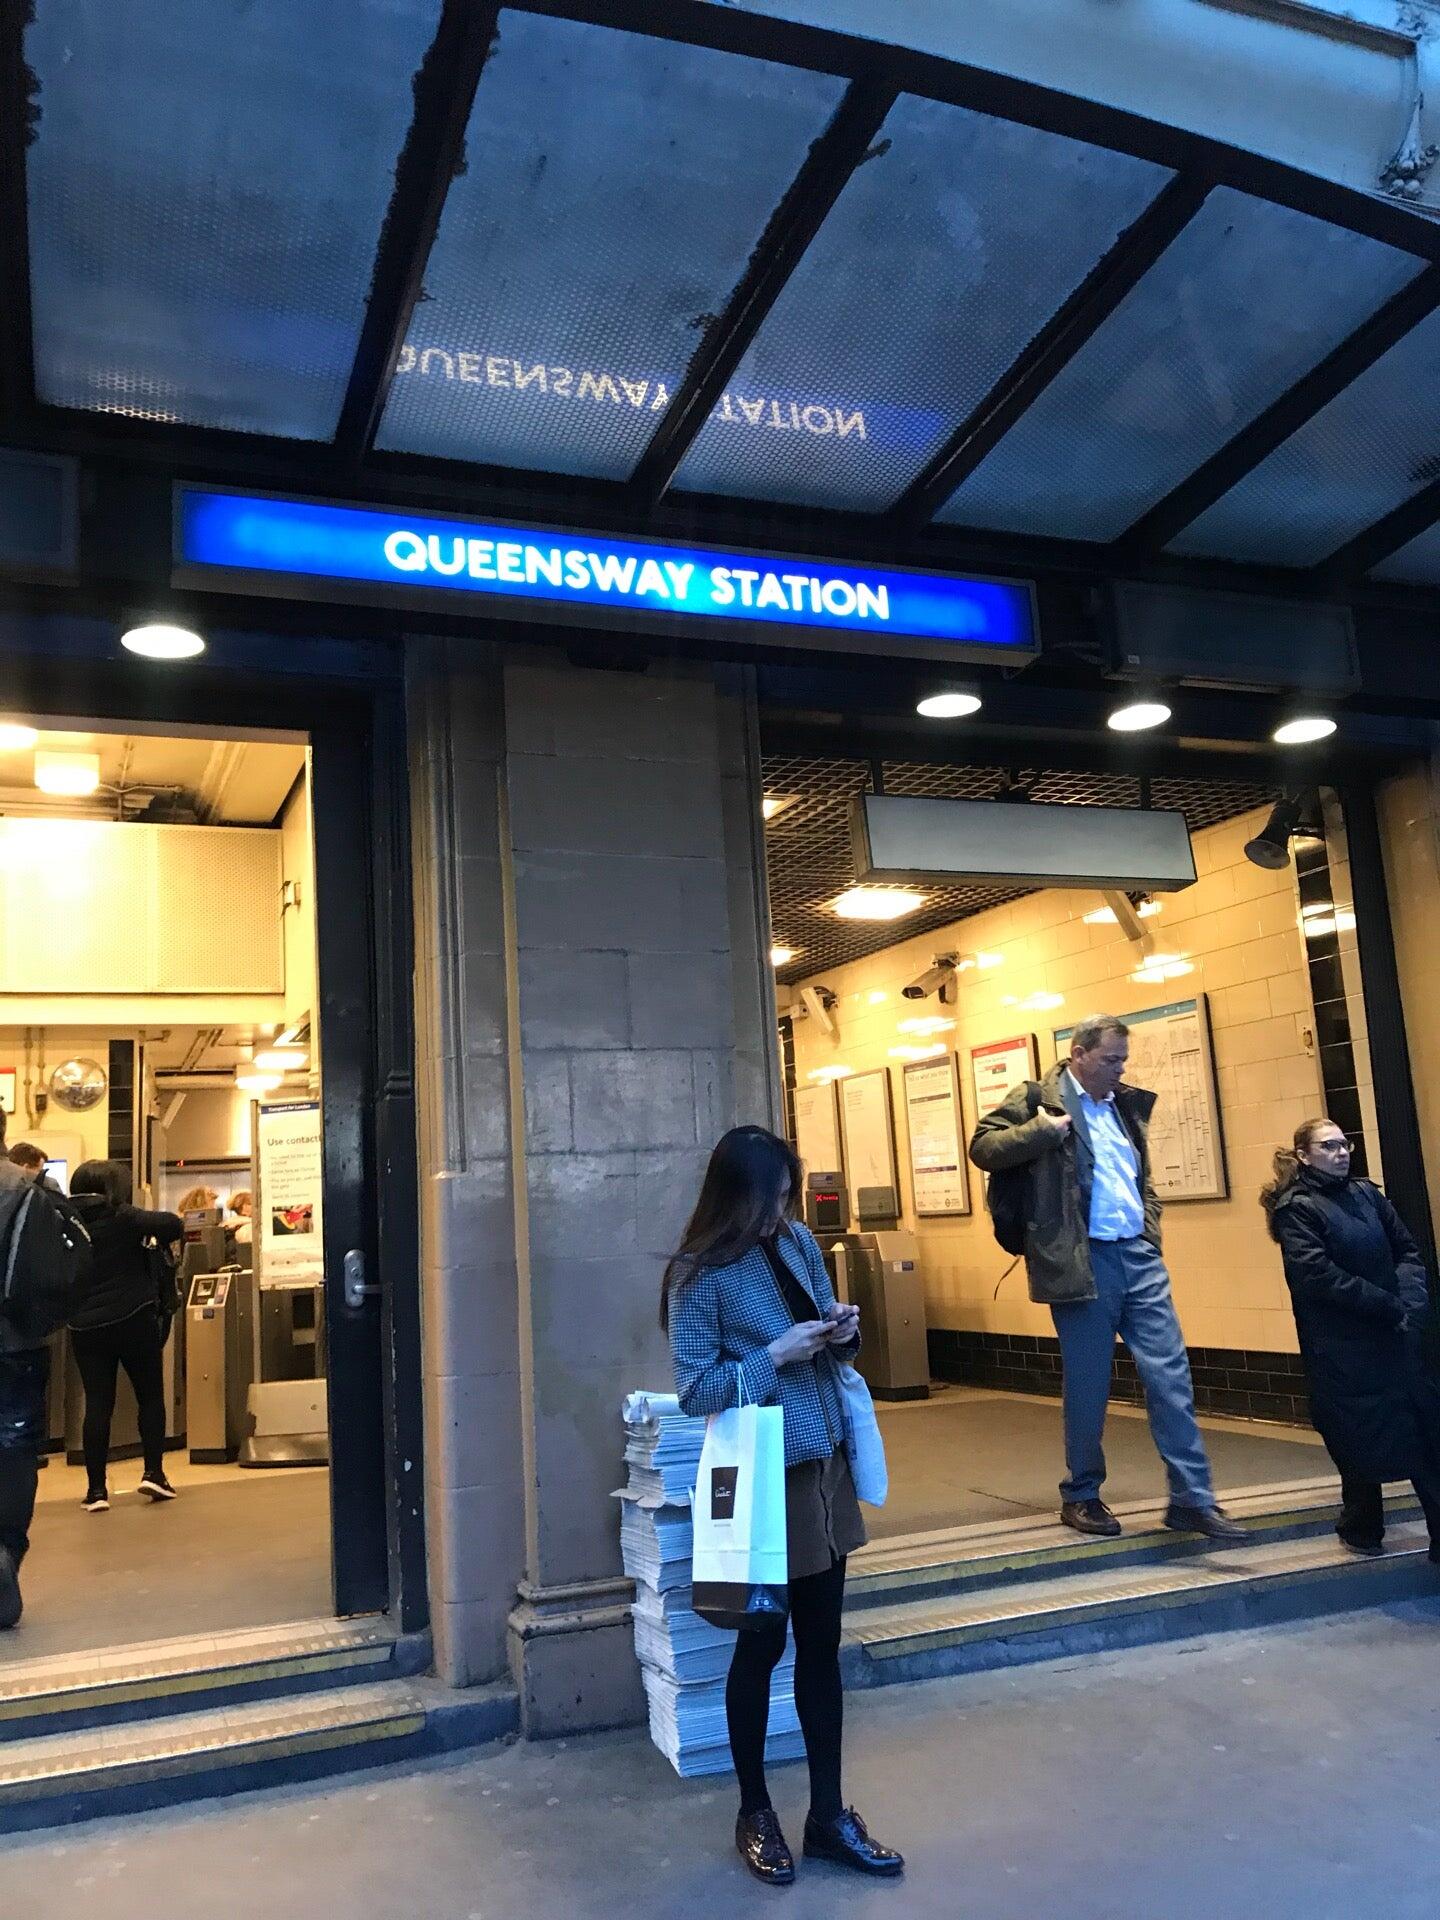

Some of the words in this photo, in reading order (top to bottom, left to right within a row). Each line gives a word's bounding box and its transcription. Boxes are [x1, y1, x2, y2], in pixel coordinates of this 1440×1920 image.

[383, 530, 695, 600] QUEENSWAY
[710, 566, 890, 621] STATION
[267, 1138, 284, 1147] Use
